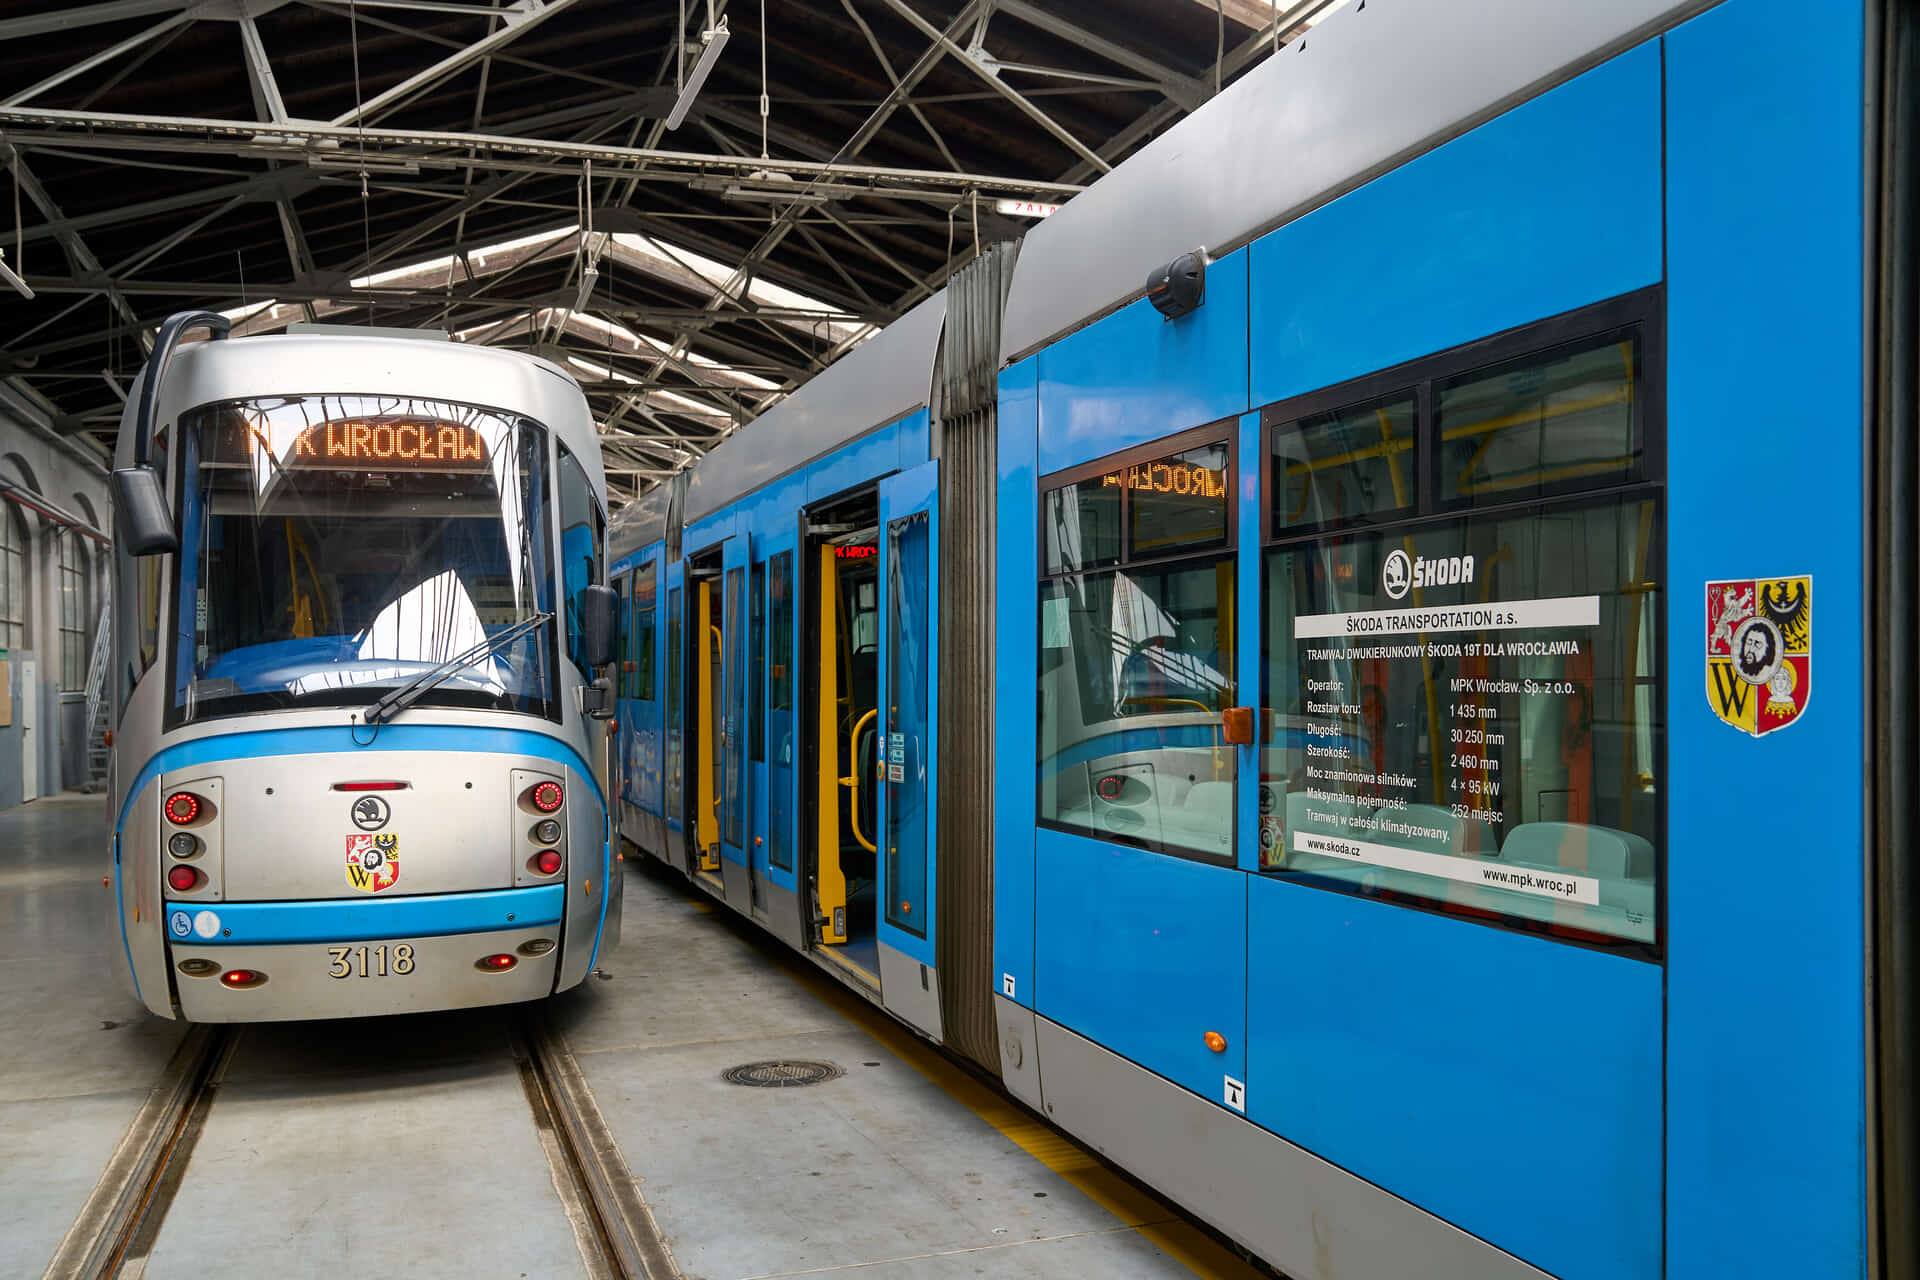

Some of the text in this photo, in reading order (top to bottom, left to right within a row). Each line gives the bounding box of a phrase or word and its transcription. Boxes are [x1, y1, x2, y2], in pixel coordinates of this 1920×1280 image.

[327, 423, 481, 459] WROCŁAW
[1412, 555, 1474, 588] ŠKODA
[1346, 610, 1518, 633] ŠKODA TRANSPORTATION a.s.
[1307, 640, 1579, 661] TRAMWAJ DWUKIERUNKOWY ŠKODA 19T DLA WROCŁAWIA
[1307, 679, 1344, 694] Operator:
[1450, 678, 1474, 693] MPK
[1524, 678, 1542, 696] Sp.
[1545, 683, 1552, 694] z
[1554, 682, 1576, 694] o.o.
[1307, 701, 1361, 714] Rozstaw toru:
[1457, 704, 1476, 719] 435
[1478, 707, 1497, 719] mm
[1307, 723, 1342, 738] Długość:
[1450, 729, 1505, 745] 30 250 mm
[1307, 743, 1351, 759] Szerokość:
[1450, 754, 1499, 771] 2 460 mm
[1306, 765, 1417, 788] Moc znamionowa silników:
[1450, 778, 1457, 791] 4
[1468, 779, 1481, 794] 95
[1483, 780, 1500, 796] kW
[1306, 787, 1407, 810] Maksymalna pojemność:
[1450, 804, 1504, 825] 252 miejsc
[1306, 808, 1450, 844] Tramwaj w całości klimatyzowany.
[1307, 840, 1360, 856] www.skoda.cz
[1483, 867, 1577, 895] www.mpk.wroc.pl
[327, 943, 416, 979] 3118
